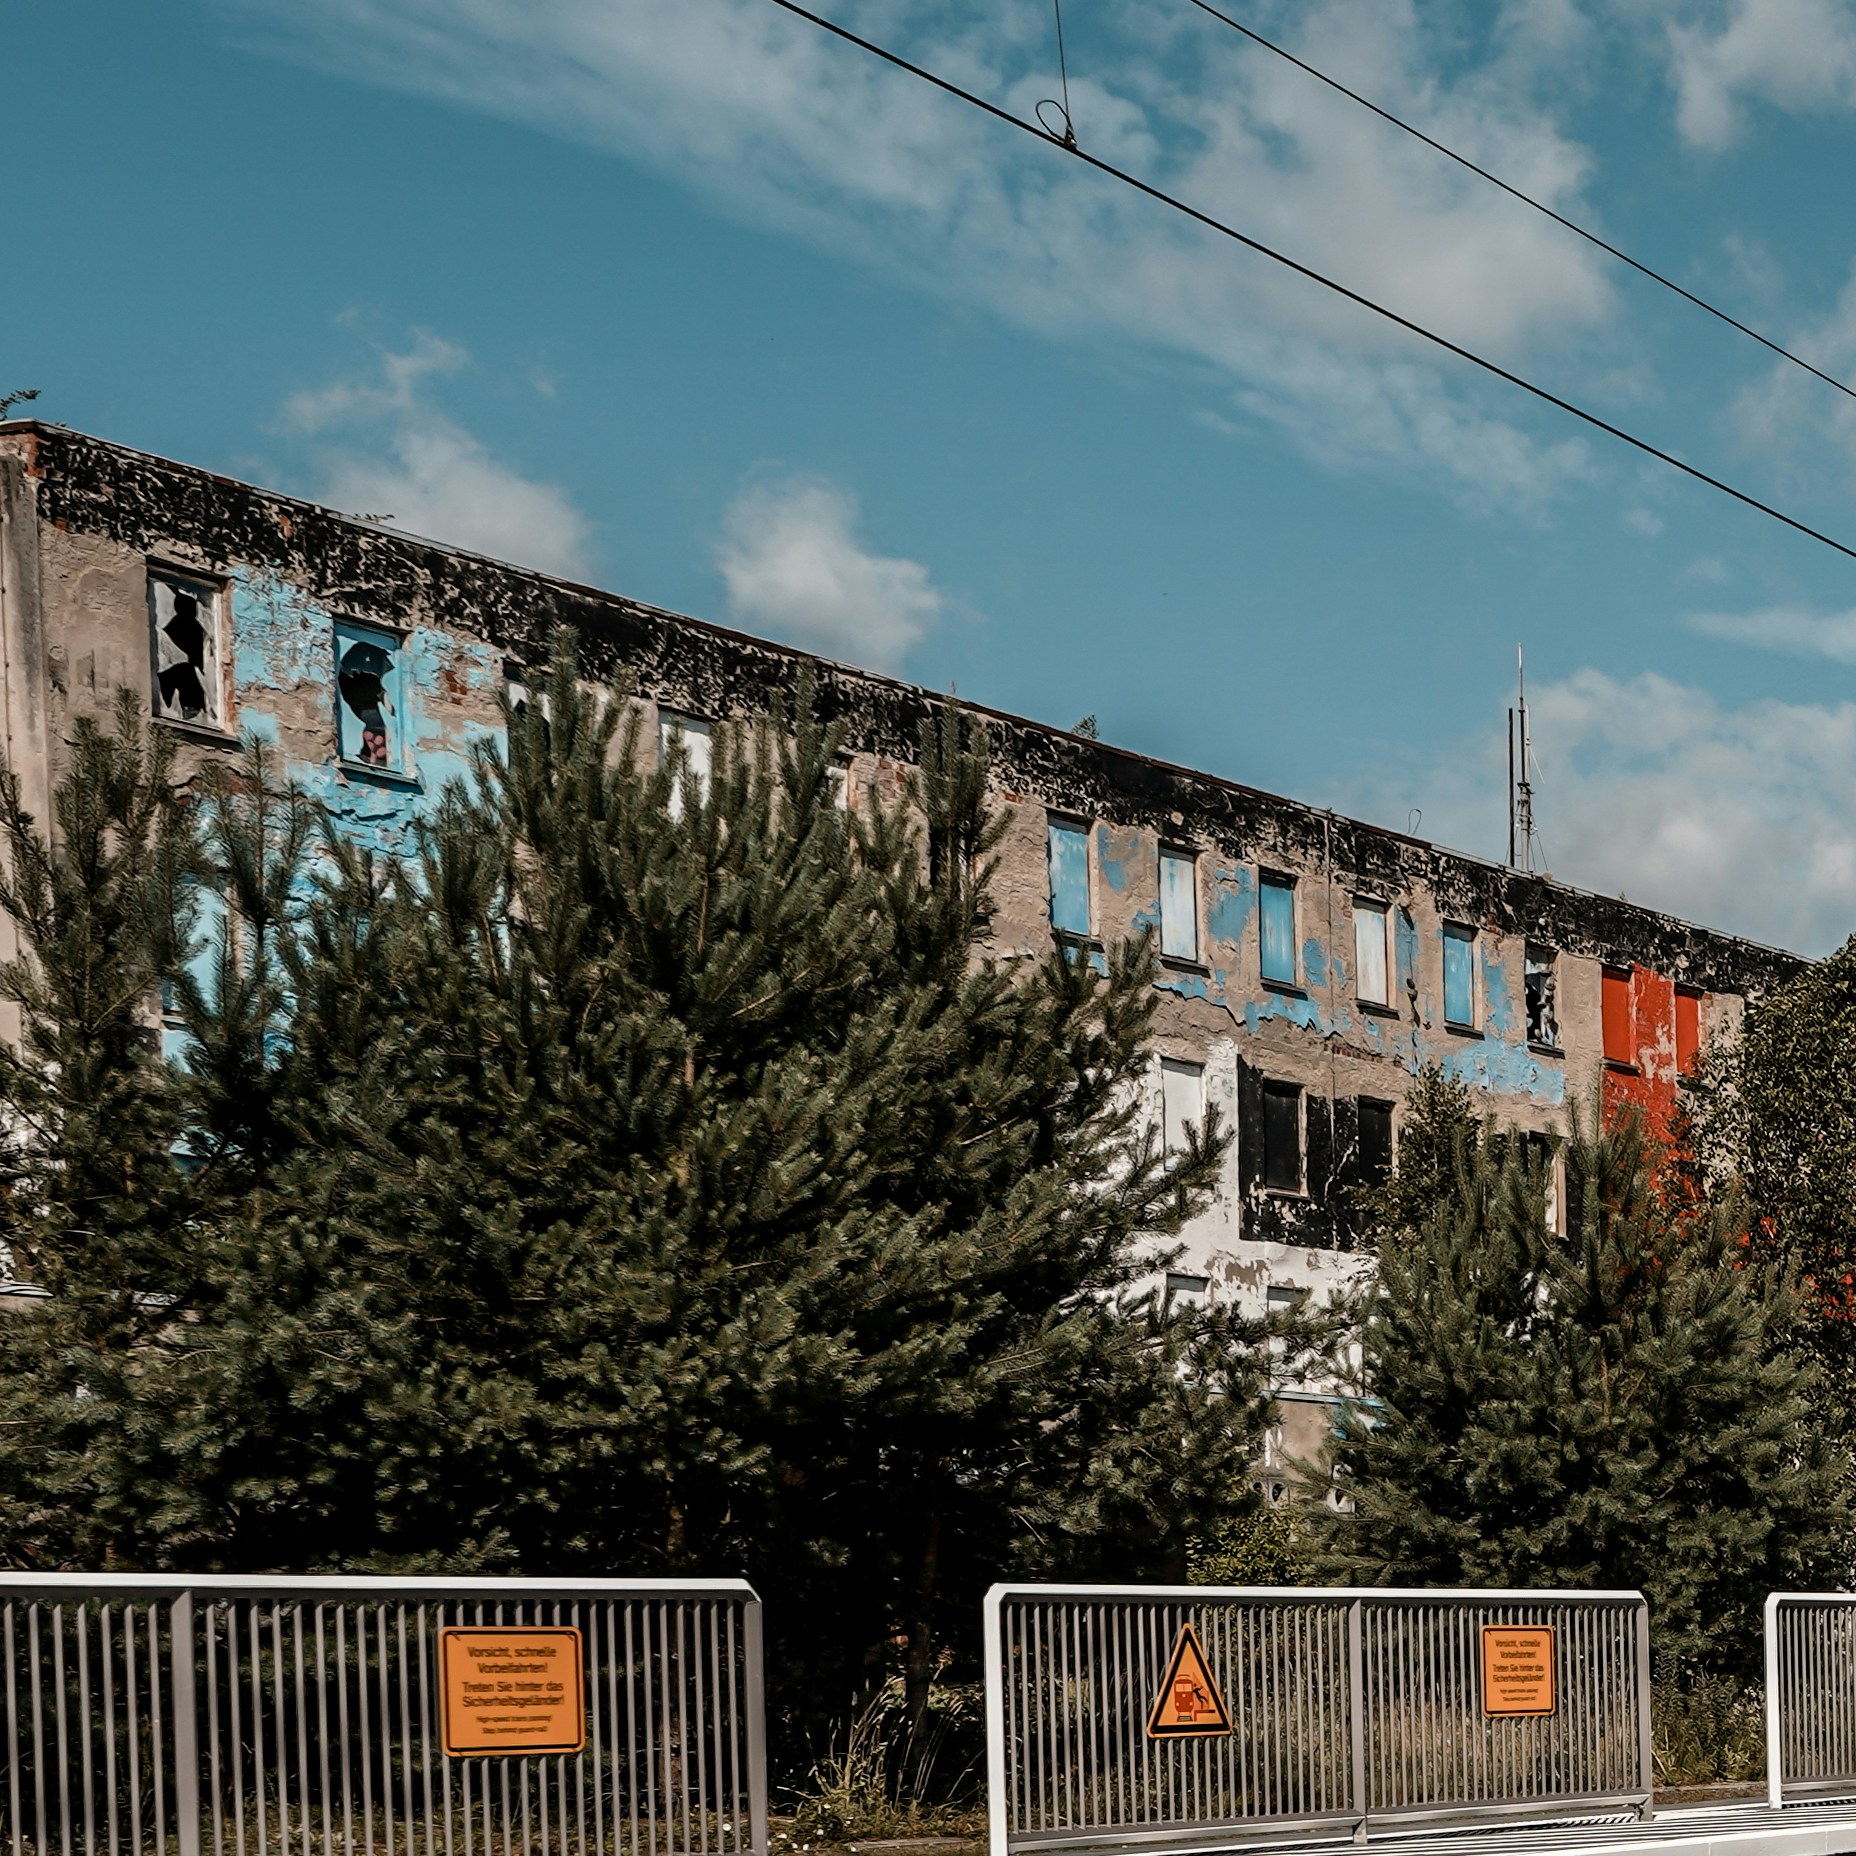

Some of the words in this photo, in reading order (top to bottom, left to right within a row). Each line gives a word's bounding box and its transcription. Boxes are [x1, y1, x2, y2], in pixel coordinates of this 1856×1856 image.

[467, 1646, 512, 1658] Vorsicht,
[461, 1681, 494, 1692] Treten
[496, 1681, 513, 1692] Sie
[546, 1681, 564, 1691] das
